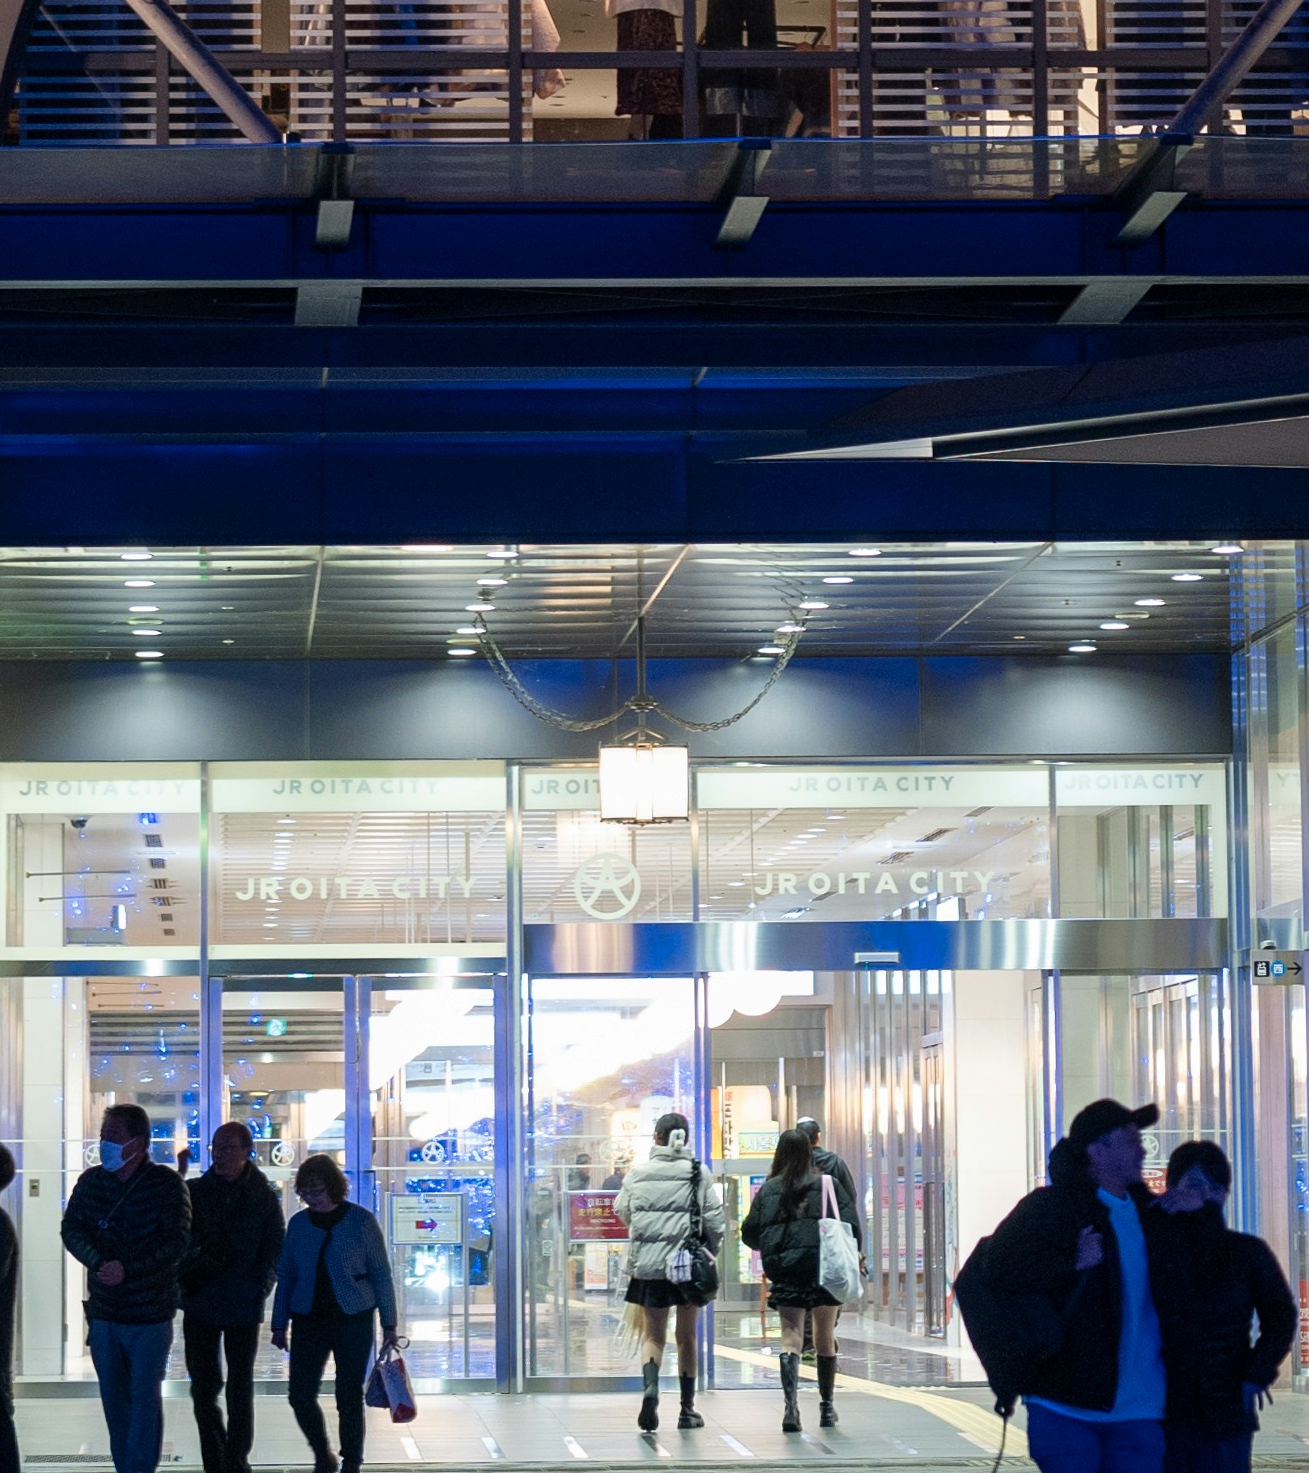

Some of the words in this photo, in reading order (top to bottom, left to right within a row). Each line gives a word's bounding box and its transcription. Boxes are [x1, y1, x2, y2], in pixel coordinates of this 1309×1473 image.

[19, 780, 48, 796] JR
[57, 780, 118, 796] OITA
[127, 780, 185, 796] CITY
[273, 779, 302, 795] JR
[310, 779, 371, 795] OITA
[380, 779, 438, 795] CITY
[531, 779, 560, 795] JR
[789, 777, 818, 792] JR
[827, 777, 888, 792] OITA
[896, 776, 954, 792] CITY
[1064, 774, 1091, 790] JR
[1095, 774, 1147, 790] OITA
[1152, 773, 1204, 789] CITY
[235, 877, 279, 901] JR
[290, 877, 380, 901] OITA
[392, 877, 478, 900] CITY
[754, 872, 797, 896] JR
[808, 871, 899, 895] OITA
[909, 870, 995, 895] CITY
